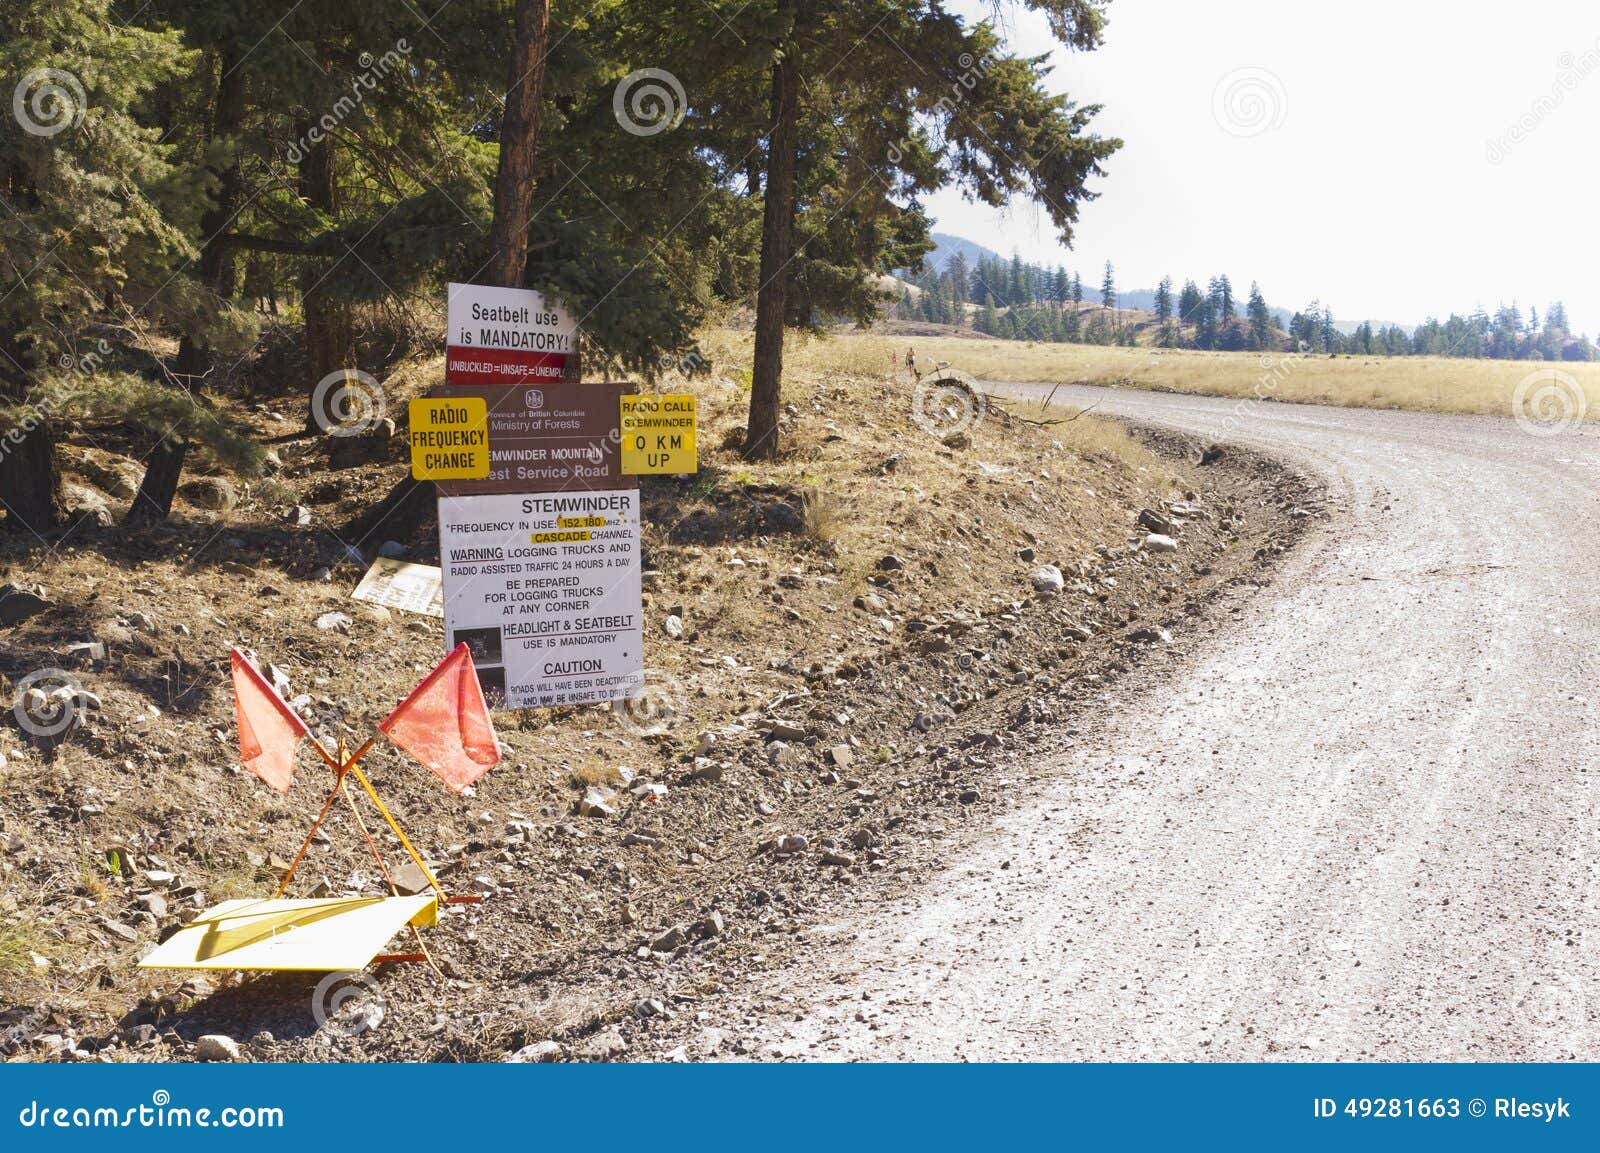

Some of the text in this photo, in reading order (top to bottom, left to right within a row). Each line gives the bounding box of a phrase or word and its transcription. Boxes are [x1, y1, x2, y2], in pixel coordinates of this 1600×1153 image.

[472, 303, 558, 325] Seatbelt use
[461, 327, 568, 351] is MANDATORY!
[519, 410, 526, 418] of
[528, 410, 551, 418] British
[553, 409, 585, 417] Columbia
[623, 402, 694, 412] RADIO CALL
[430, 408, 468, 424] RADIO
[624, 418, 693, 427] STEMWINDER
[491, 419, 581, 433] Ministry of Forests
[412, 430, 485, 449] FREQUENCY
[657, 435, 682, 450] KM
[425, 452, 476, 470] CHANGE
[551, 448, 603, 461] MOUNTAIN
[648, 453, 670, 467] UP
[517, 466, 569, 480] Service
[574, 464, 609, 478] Road
[522, 496, 631, 514] STEMWINDER
[450, 522, 515, 533] FREQUENCY
[519, 521, 529, 530] IN
[533, 519, 557, 530] USE:
[563, 518, 601, 529] 152.180
[535, 530, 633, 543] CASCADE CHANNEL
[450, 543, 631, 561] WARNING LOGGING TRUCKS AND
[450, 558, 631, 577] RADIO ASSISTED TRAFFIC 24 HOURS A DAY
[506, 576, 580, 590] BE PREPARED
[485, 586, 604, 603] FOR LOGGING TRUCKS
[502, 600, 590, 615] AT ANY CORNER
[503, 615, 634, 636] HEADLIGHT & SEATBELT
[523, 634, 617, 650] USE IS MANDATORY
[543, 659, 602, 676] CAUTION
[537, 683, 552, 691] WILL
[555, 681, 572, 690] HAVE
[574, 679, 593, 689] BEEN
[523, 697, 538, 706] AND
[540, 696, 553, 704] MAY
[556, 694, 566, 703] BE
[568, 691, 595, 702] UNSAFE
[598, 690, 608, 699] TO
